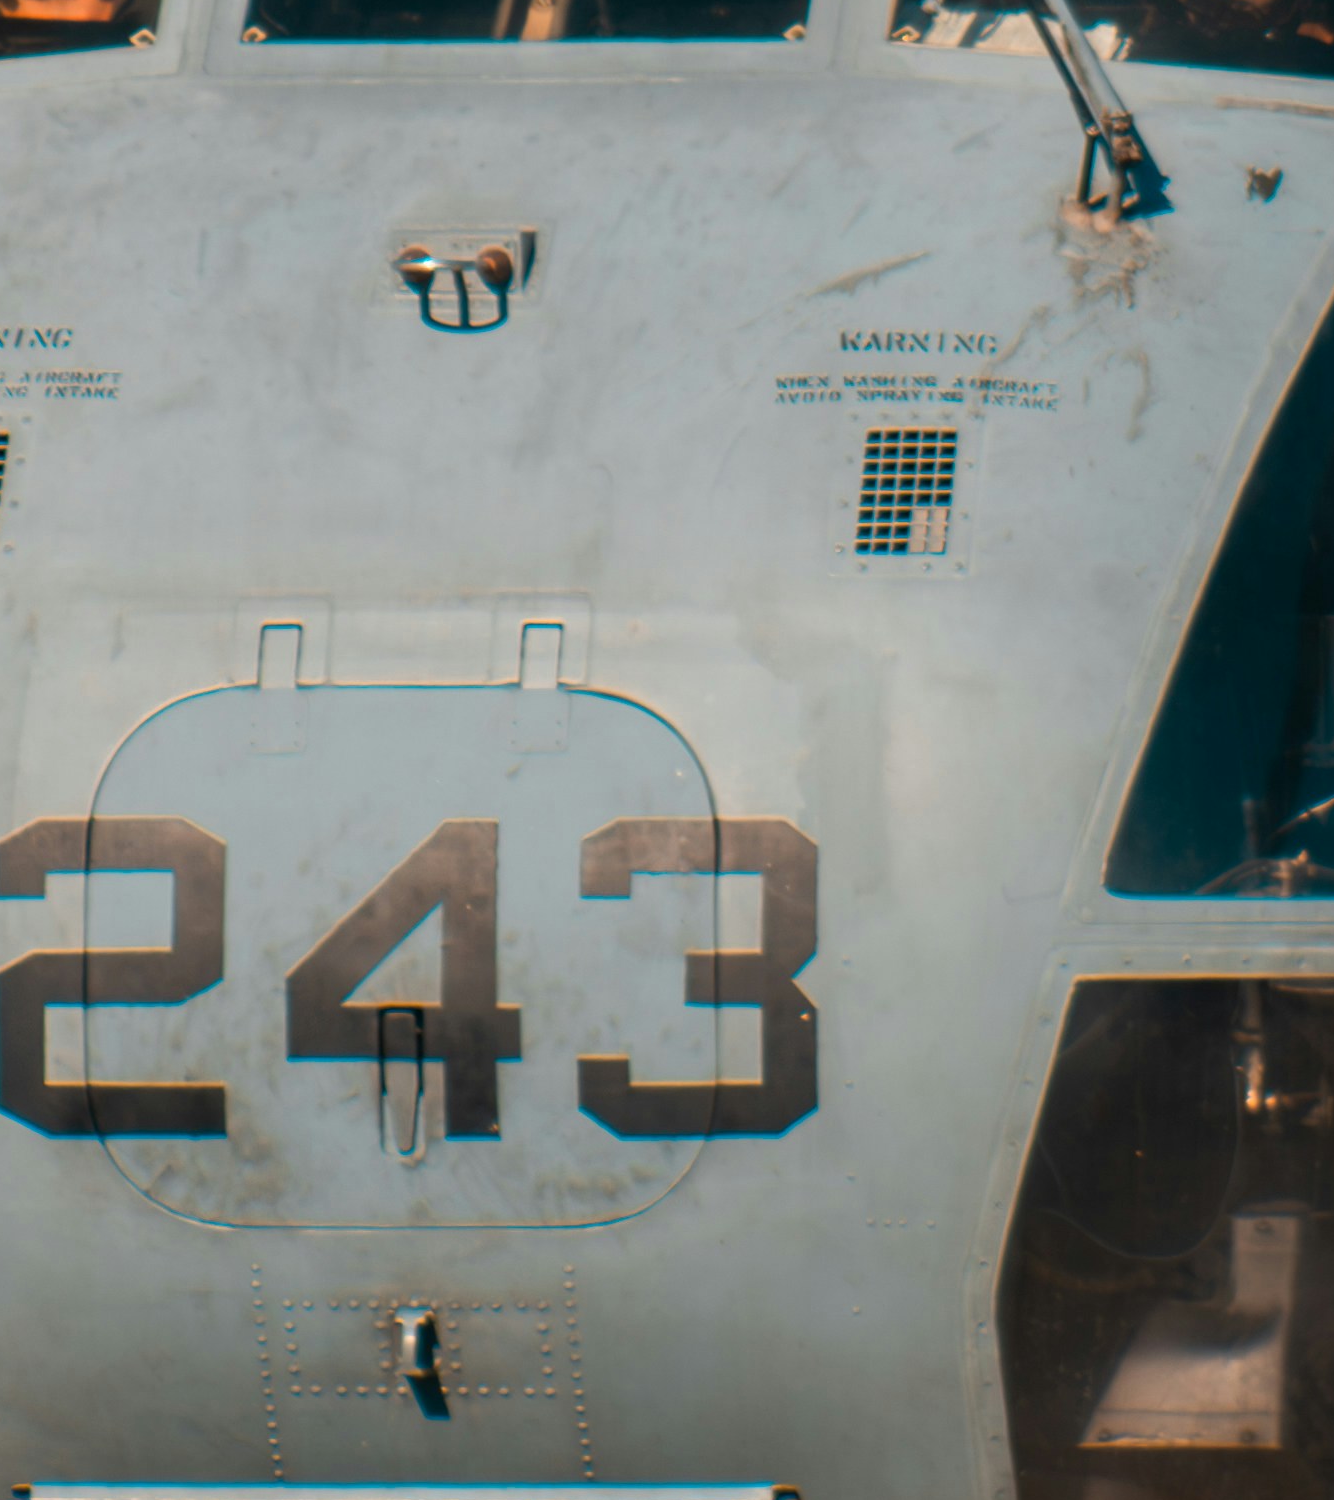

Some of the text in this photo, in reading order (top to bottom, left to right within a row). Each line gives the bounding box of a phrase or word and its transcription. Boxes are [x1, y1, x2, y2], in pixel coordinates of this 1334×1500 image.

[839, 329, 999, 354] WARNING
[19, 370, 123, 384] AIRCRAFT
[775, 374, 1059, 394] WHEN WASHING AIRCRAFT
[44, 385, 120, 400] INTAKE
[775, 389, 1059, 412] AVOID SPRAYING INTAKE
